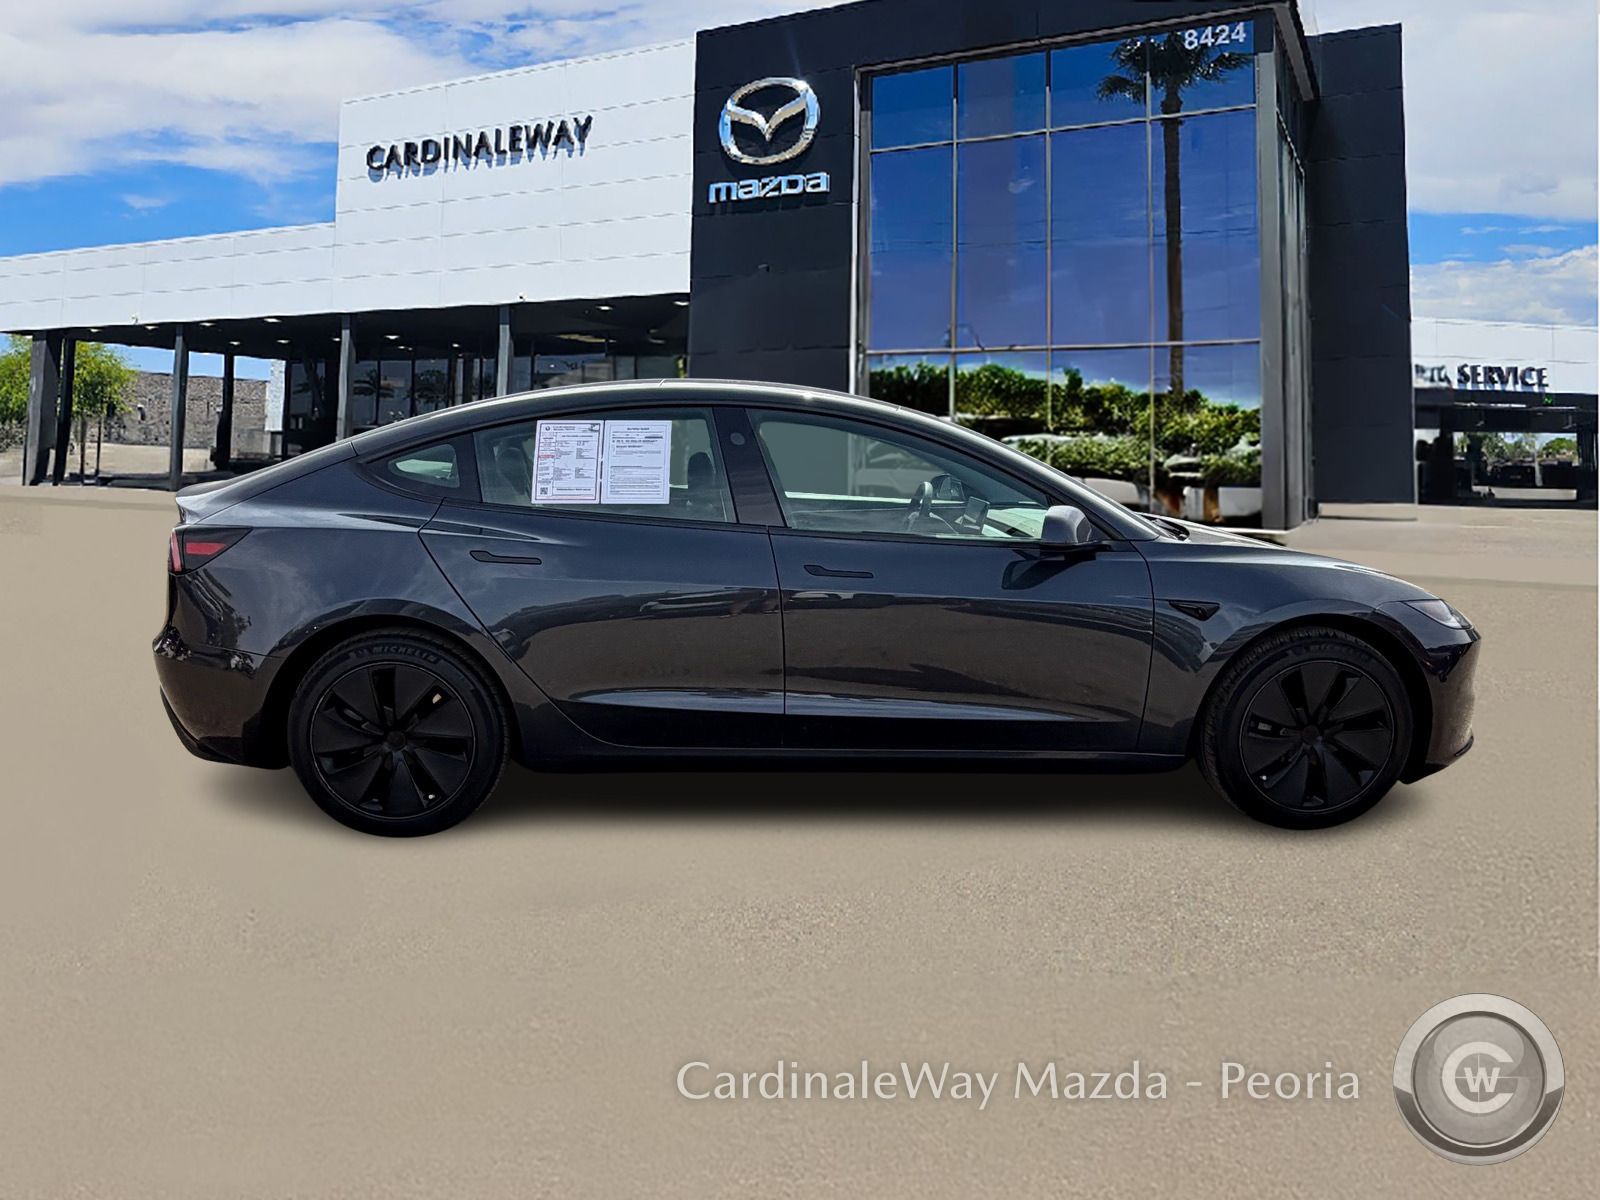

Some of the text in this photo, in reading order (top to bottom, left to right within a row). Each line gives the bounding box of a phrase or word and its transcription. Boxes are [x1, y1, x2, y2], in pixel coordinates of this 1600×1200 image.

[1184, 22, 1246, 50] 8424
[366, 115, 593, 171] CARDINALEWAY
[1457, 363, 1549, 389] SERVICE
[372, 645, 438, 663] MICHELIN
